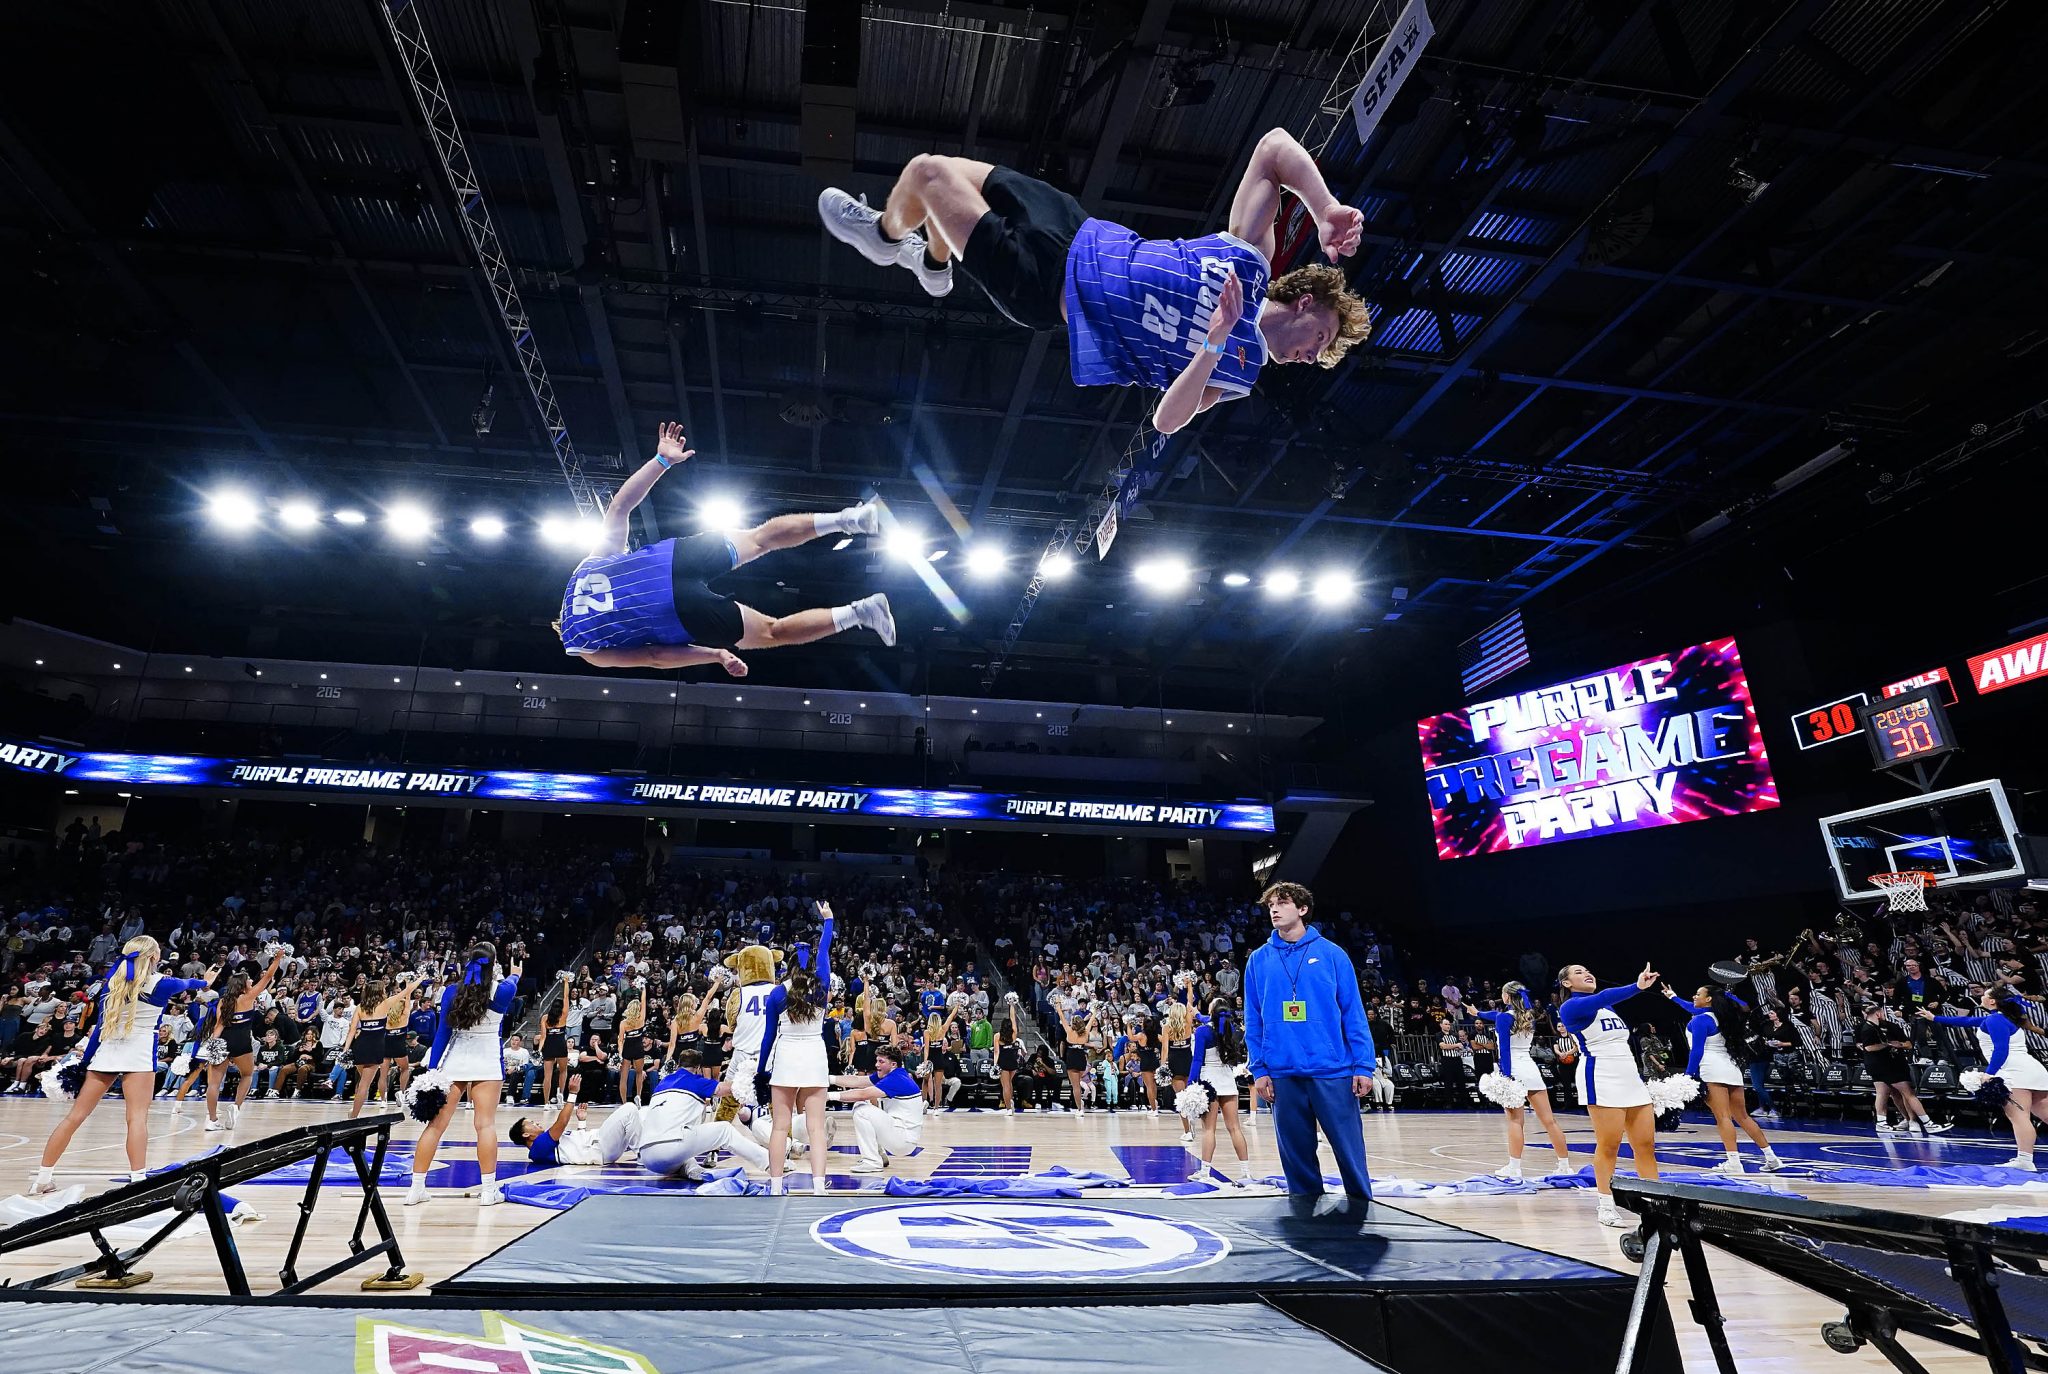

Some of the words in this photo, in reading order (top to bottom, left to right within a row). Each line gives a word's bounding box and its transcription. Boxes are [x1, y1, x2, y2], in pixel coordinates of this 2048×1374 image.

[1363, 44, 1406, 116] SFA
[1142, 293, 1181, 343] 23
[1152, 432, 1171, 459] CB
[316, 686, 342, 699] 205
[523, 697, 547, 709] 204
[1468, 660, 1678, 743] PURPLE
[829, 713, 852, 725] 203
[1047, 725, 1069, 736] 202
[1809, 703, 1856, 741] 30
[1888, 721, 1934, 757] 30
[0, 742, 79, 773] ARTY
[1425, 703, 1746, 810] PREGAME
[232, 765, 304, 783] PURPLE
[302, 768, 404, 790] PREGAME
[406, 773, 483, 792] PARTY
[632, 784, 699, 801] PURPLE
[699, 785, 795, 807] PREGAME
[796, 790, 870, 810] PARTY
[1500, 771, 1678, 844] PARTY
[1006, 800, 1066, 817] PURPLE
[1068, 802, 1155, 822] PREGAME
[1158, 806, 1222, 825] PARTY
